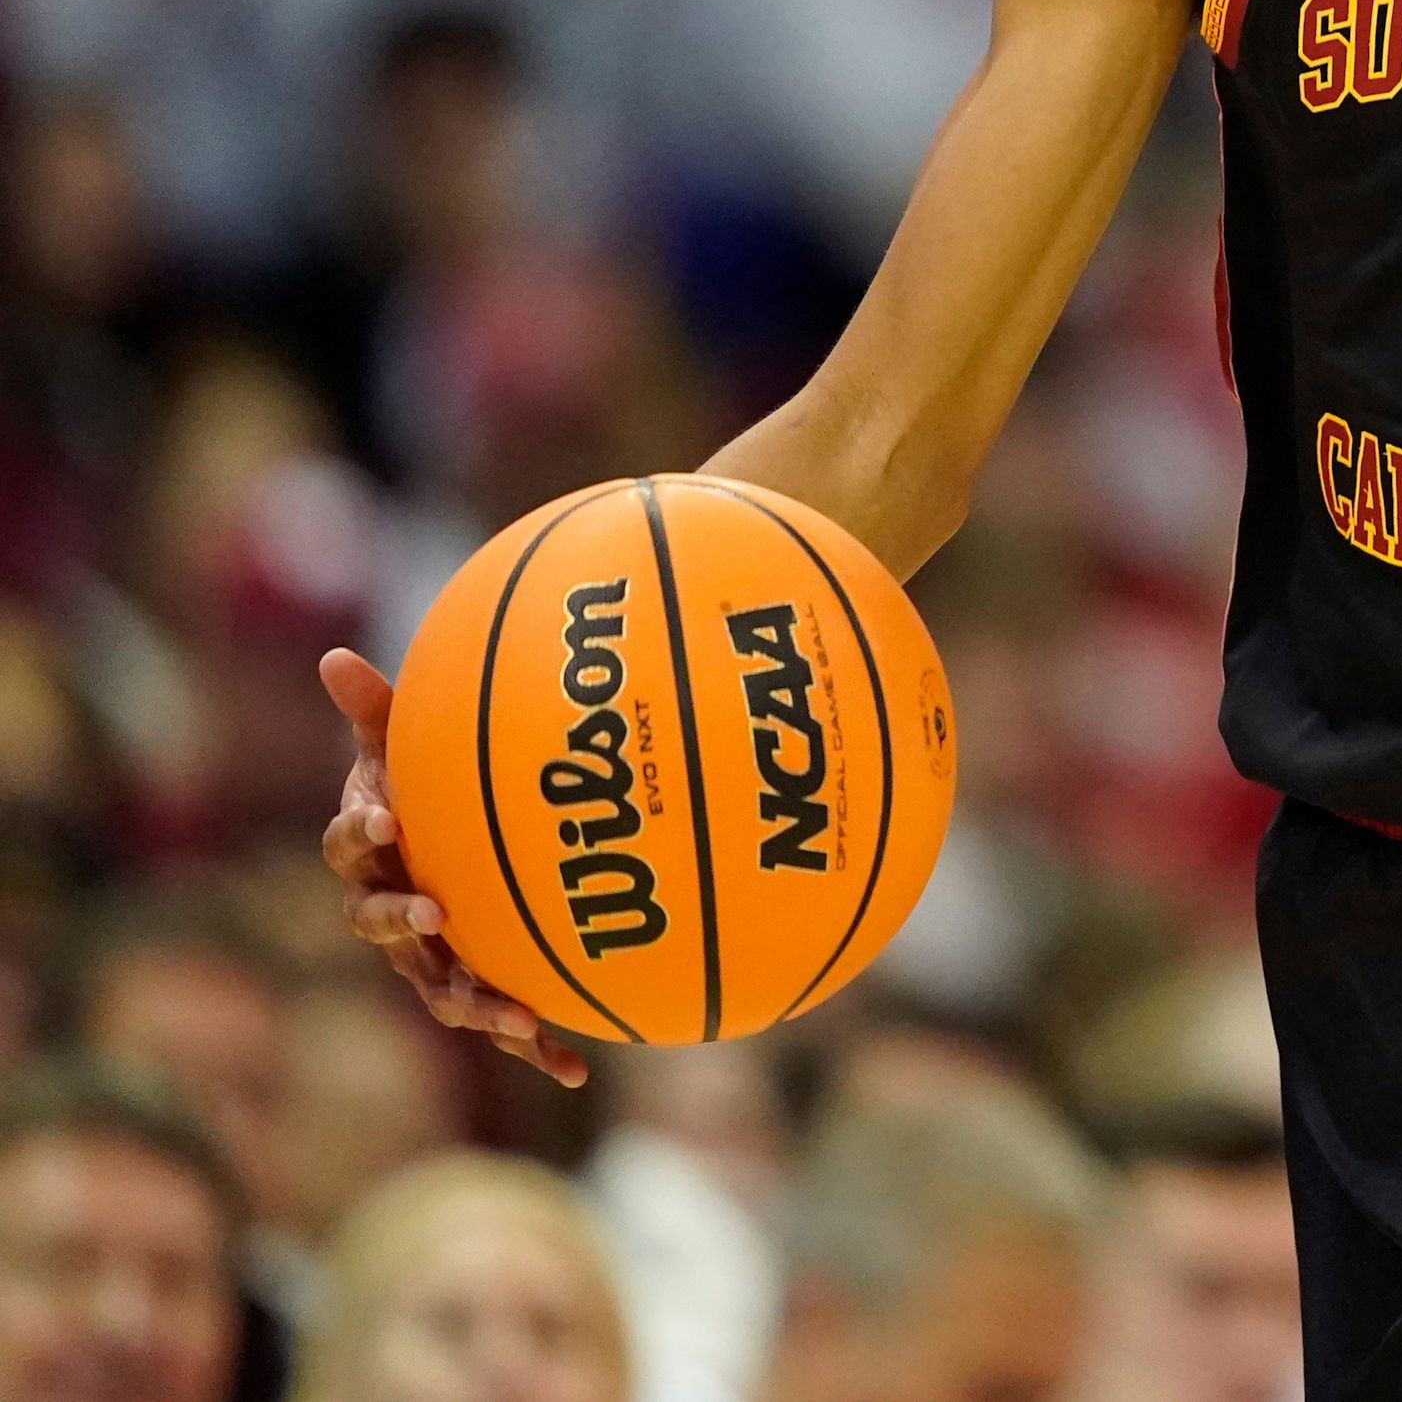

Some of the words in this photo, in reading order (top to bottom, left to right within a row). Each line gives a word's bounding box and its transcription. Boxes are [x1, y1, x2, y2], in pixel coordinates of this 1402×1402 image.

[634, 698, 654, 753] NXT
[725, 602, 829, 874] NCAA
[822, 673, 843, 751] GAME
[540, 576, 670, 962] Wilson
[642, 760, 665, 817] EVO
[834, 758, 848, 872] OFFICIAL
